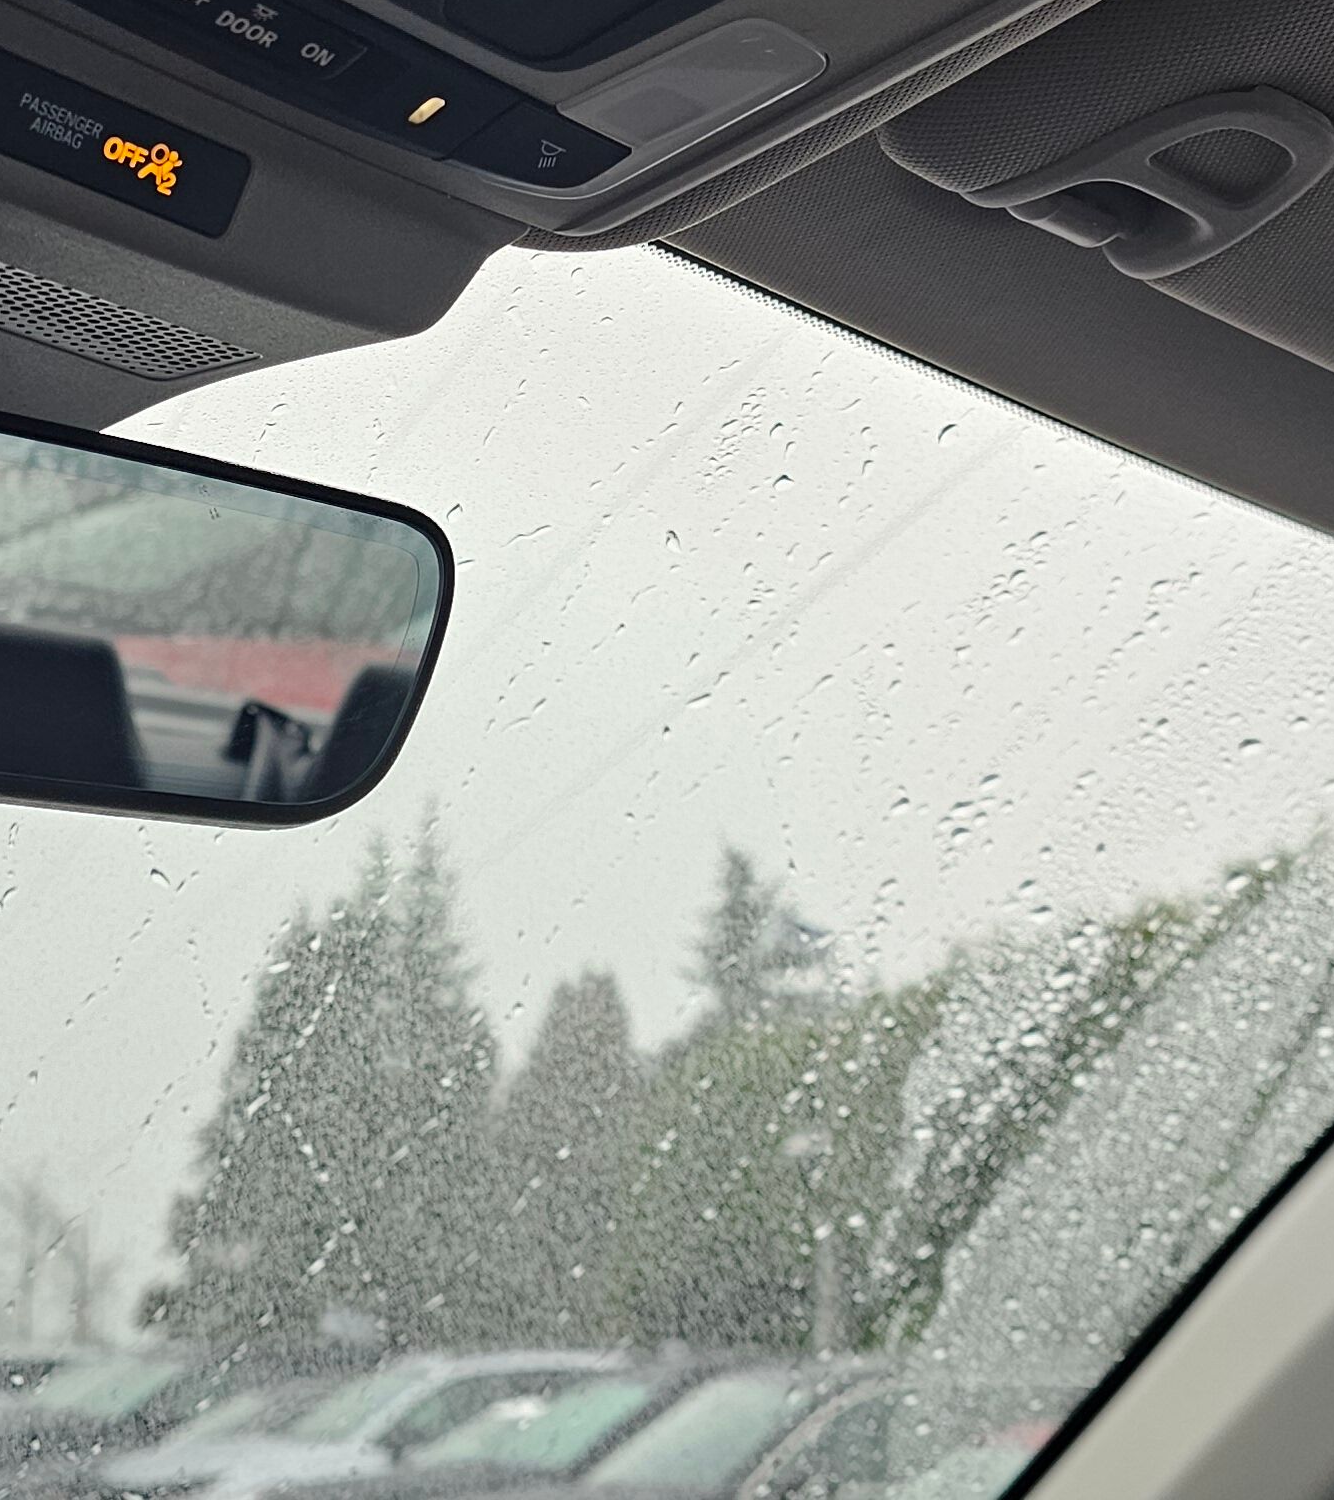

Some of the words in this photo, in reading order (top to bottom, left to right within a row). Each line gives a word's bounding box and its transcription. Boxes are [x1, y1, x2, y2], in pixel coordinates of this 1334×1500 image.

[215, 10, 278, 48] DOOR
[300, 42, 336, 67] ON
[19, 93, 104, 139] PASSENGER
[30, 117, 84, 149] AIRBAG
[103, 136, 149, 168] OFF
